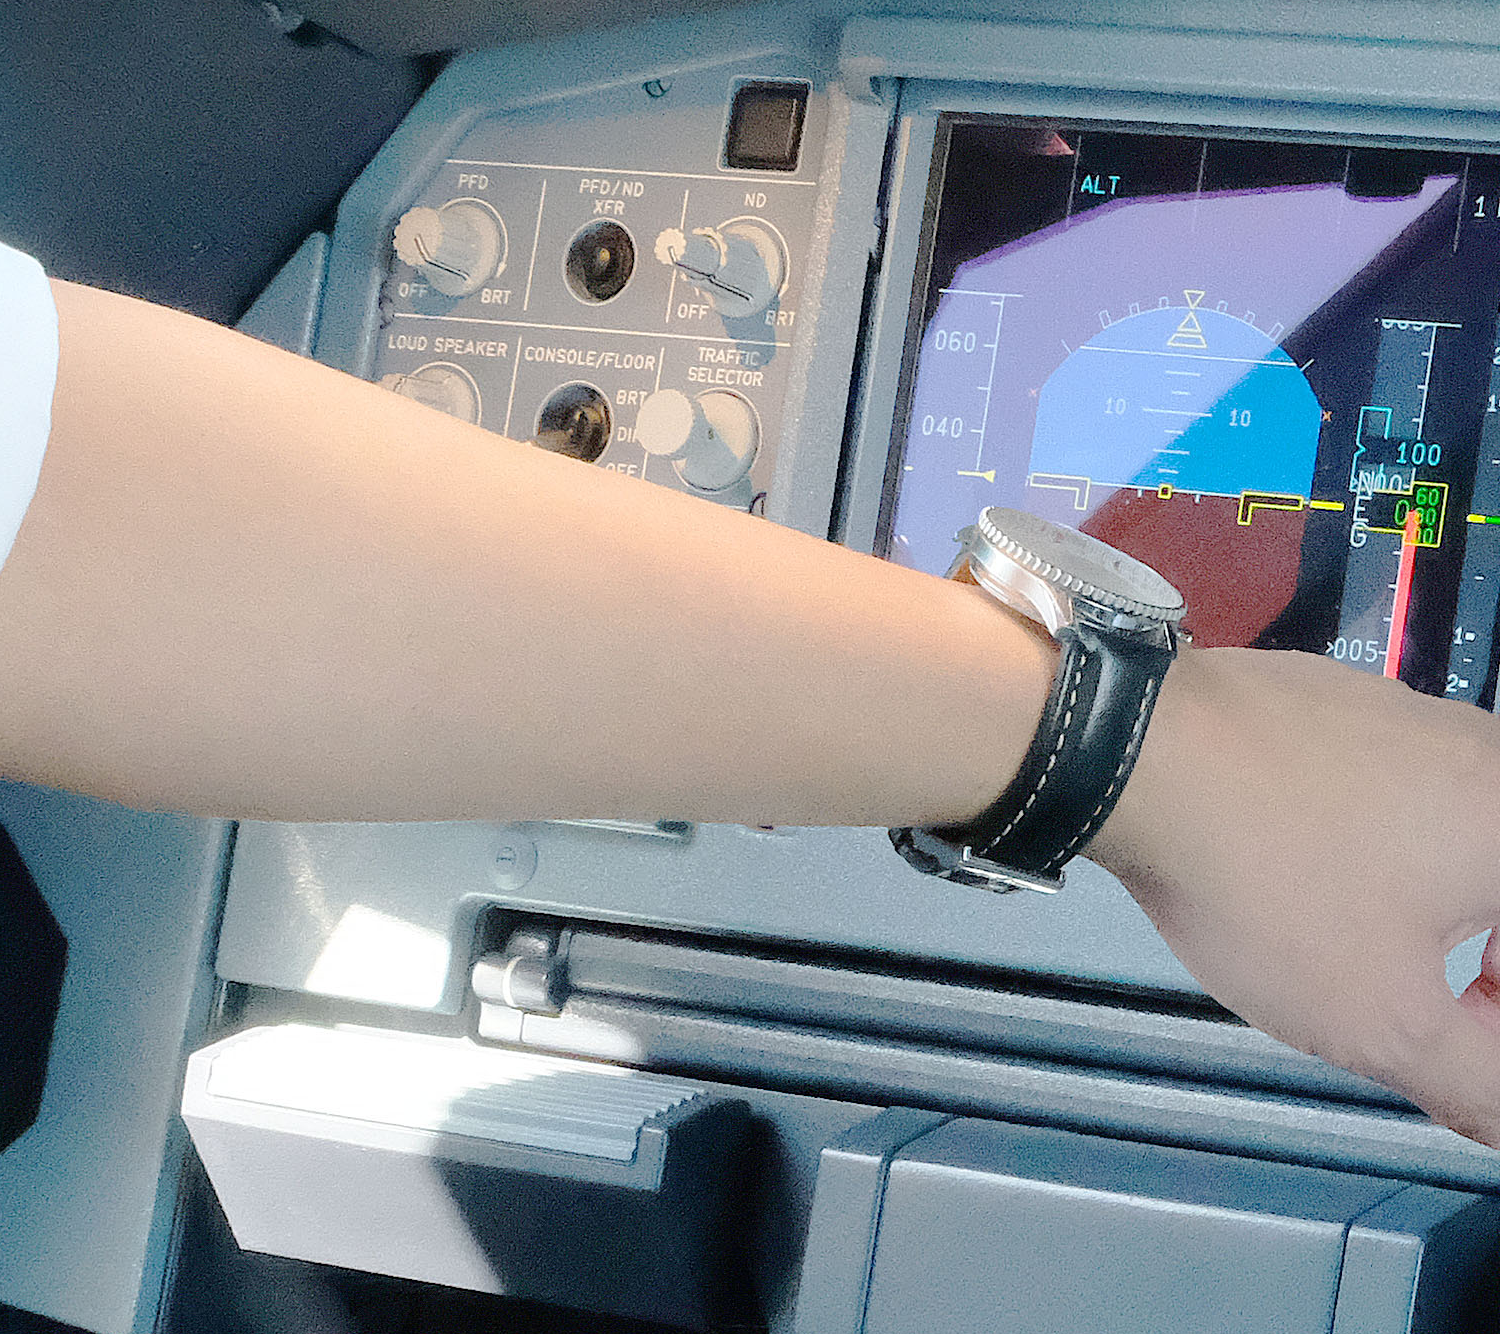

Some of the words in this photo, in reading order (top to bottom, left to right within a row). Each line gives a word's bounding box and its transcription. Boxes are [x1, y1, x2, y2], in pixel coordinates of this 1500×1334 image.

[580, 179, 644, 198] PFD/ND
[1081, 175, 1119, 196] ALT
[1474, 198, 1485, 218] 1
[388, 335, 427, 353] LOUD
[434, 338, 507, 358] SPEAKER
[524, 346, 655, 370] CONSOLE/FLOOR
[698, 348, 760, 366] TRAFFIC
